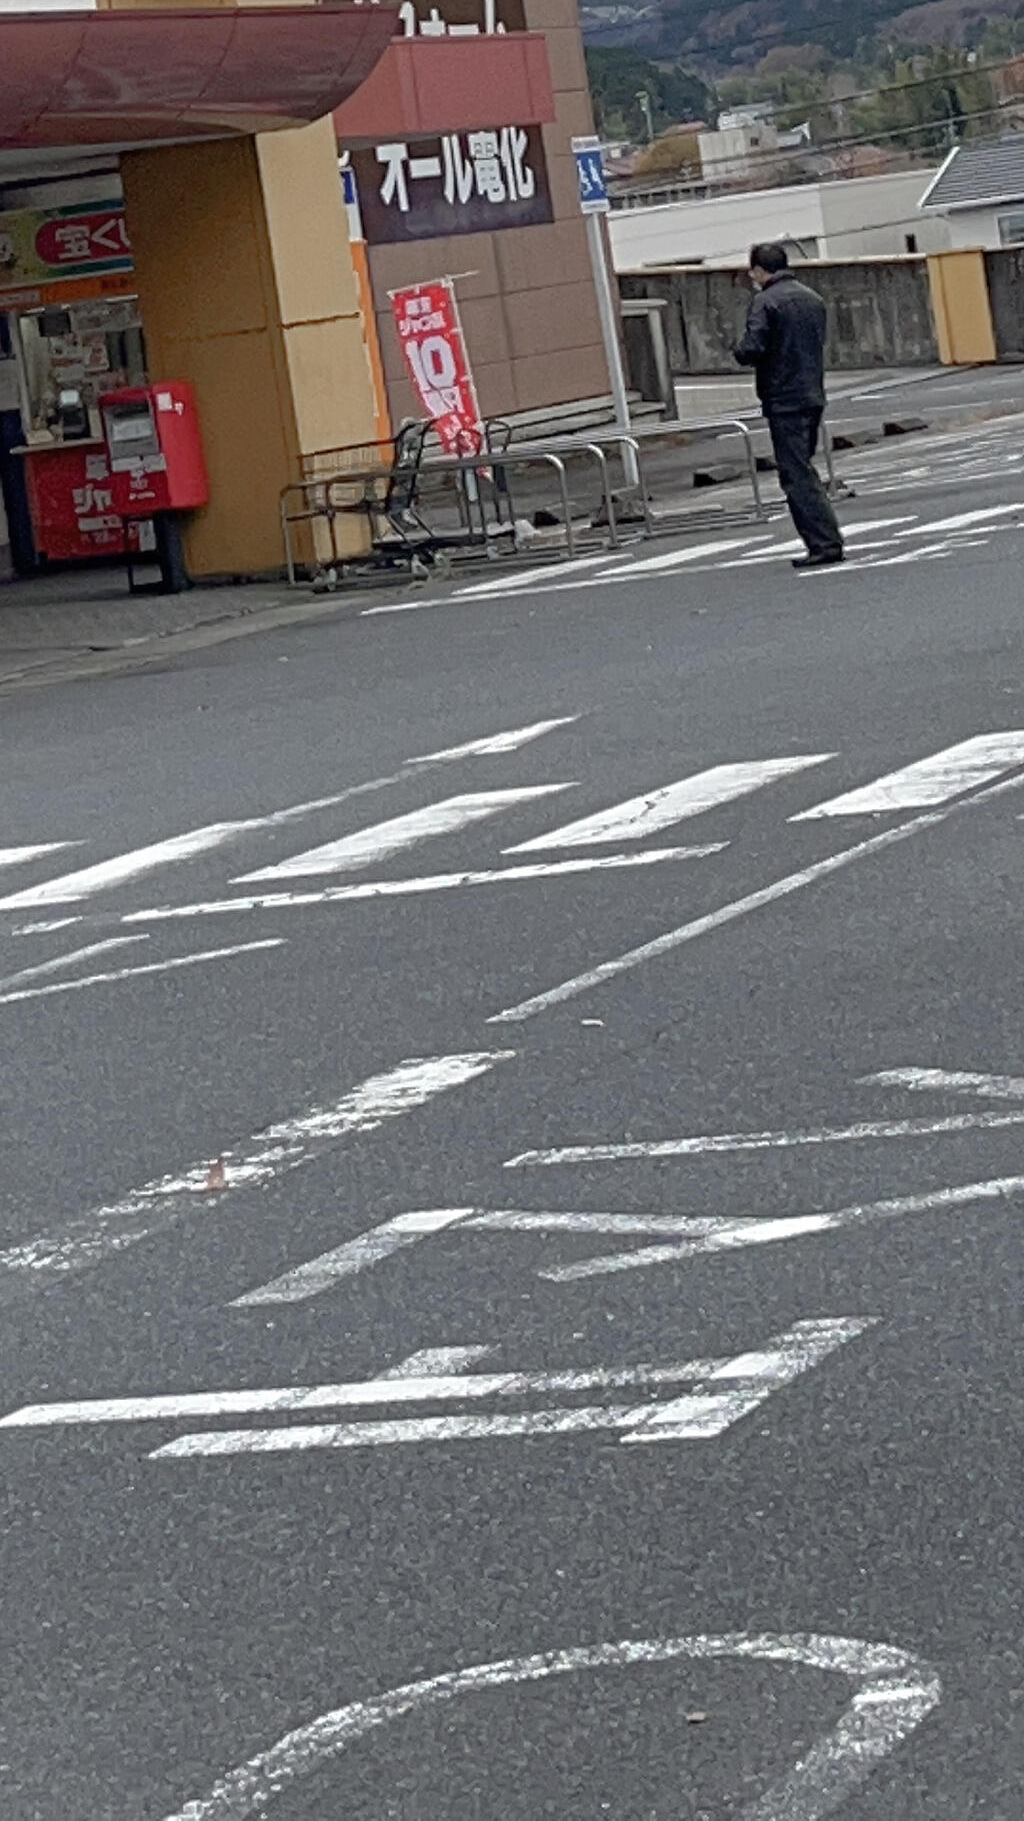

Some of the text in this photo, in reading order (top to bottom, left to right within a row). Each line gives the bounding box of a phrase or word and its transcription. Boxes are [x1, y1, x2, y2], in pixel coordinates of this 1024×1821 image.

[377, 126, 535, 212] オール電化
